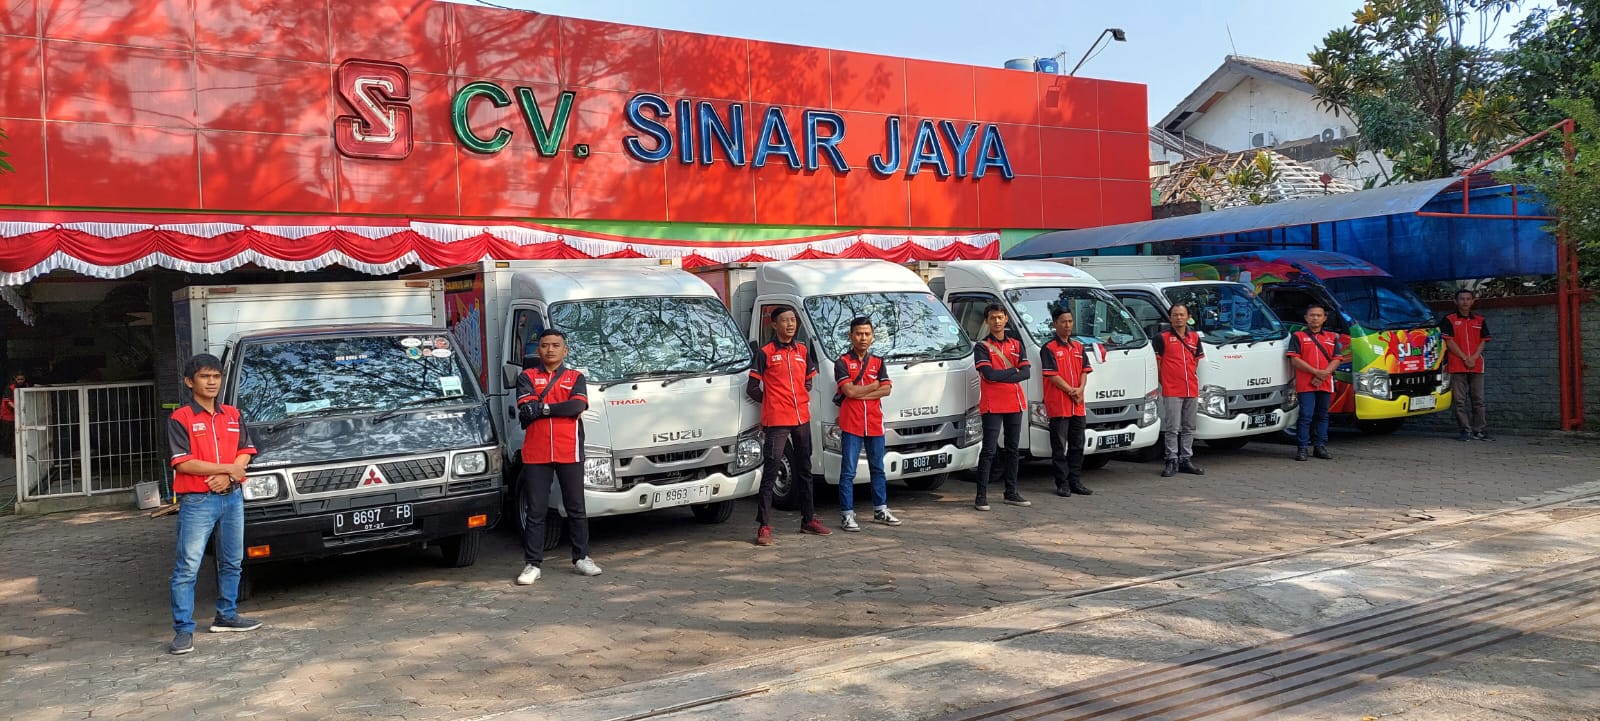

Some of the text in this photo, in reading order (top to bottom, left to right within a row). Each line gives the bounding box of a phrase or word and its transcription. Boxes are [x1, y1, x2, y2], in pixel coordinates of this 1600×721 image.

[451, 80, 1016, 181] CV. SINAR JAYA
[1246, 376, 1272, 387] ISUZU
[1095, 388, 1126, 399] ISUZU
[608, 398, 647, 406] TRAGA
[426, 411, 466, 420] COLT
[900, 405, 939, 418] ISUZU
[652, 428, 703, 444] ISUZU
[1098, 436, 1103, 446] D
[903, 459, 909, 470] D
[913, 455, 930, 468] 8087
[655, 485, 710, 503] D 8963 FT
[336, 504, 411, 527] D 8697 FB
